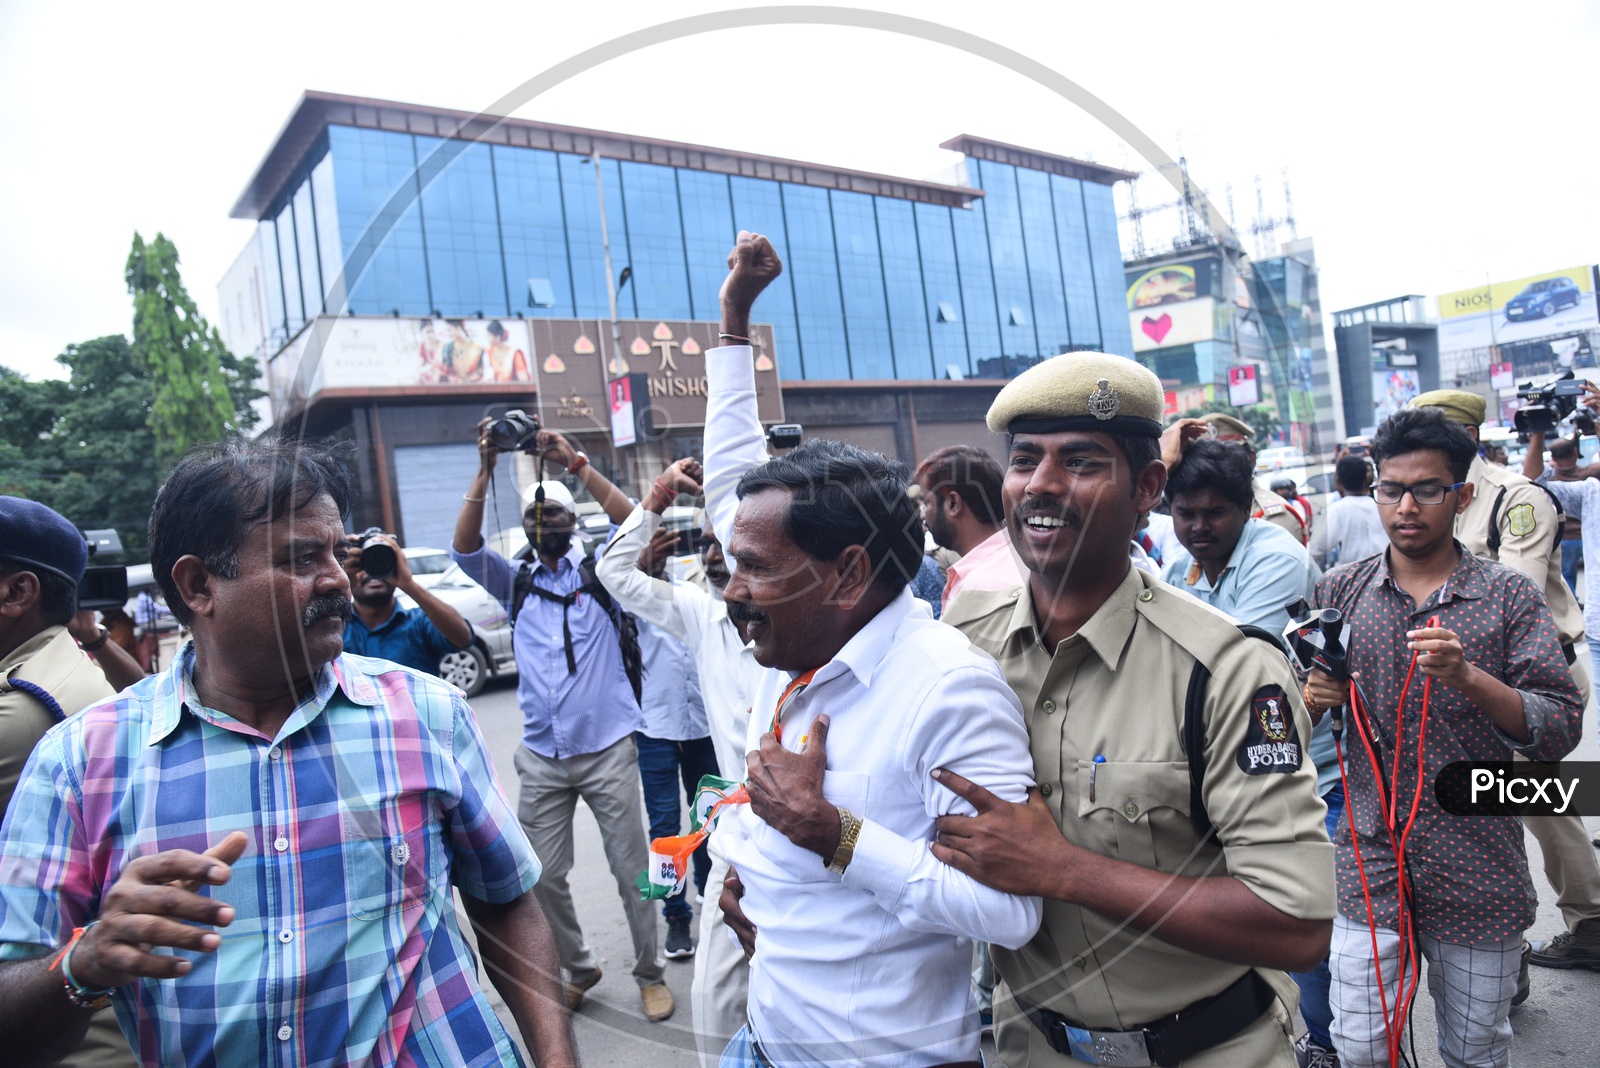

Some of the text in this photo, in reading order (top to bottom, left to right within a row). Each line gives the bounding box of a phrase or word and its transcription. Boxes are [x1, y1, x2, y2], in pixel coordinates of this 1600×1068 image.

[1455, 293, 1492, 308] NIOS
[1097, 399, 1115, 410] TSP
[1249, 752, 1298, 768] POLICE
